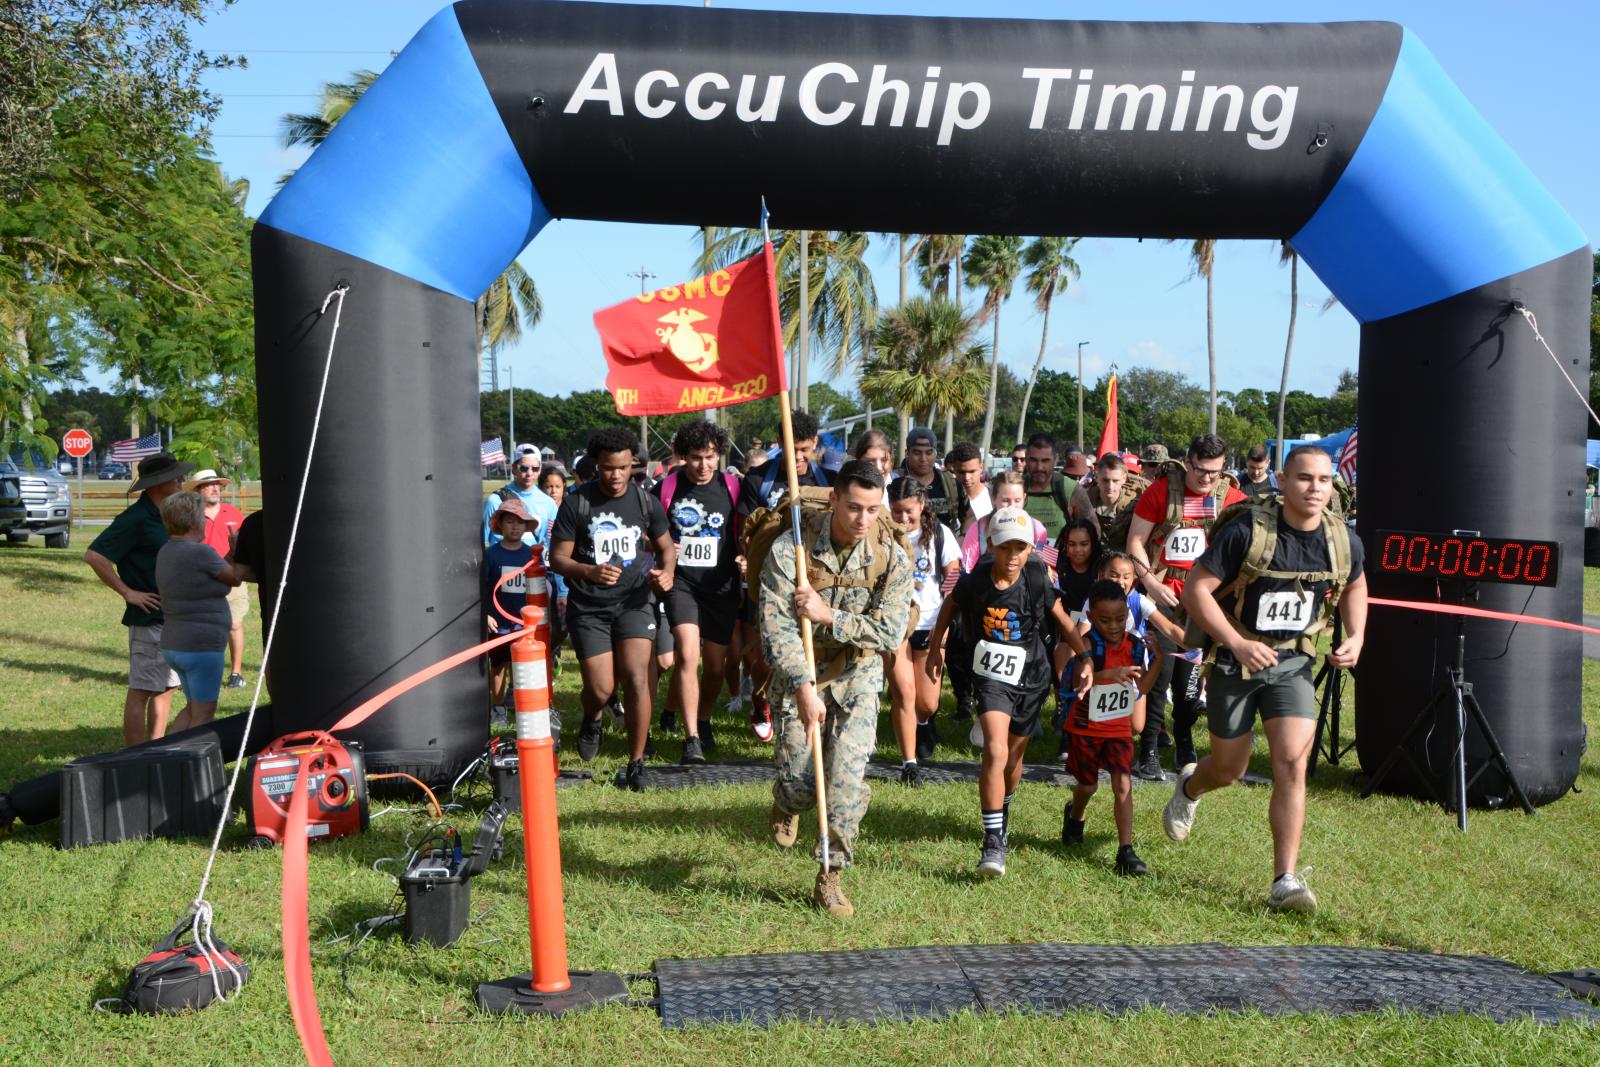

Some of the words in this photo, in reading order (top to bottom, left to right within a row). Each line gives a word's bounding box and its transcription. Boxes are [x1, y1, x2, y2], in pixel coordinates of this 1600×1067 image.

[1022, 68, 1299, 150] Timing
[678, 374, 767, 409] ANGLICO
[66, 438, 90, 448] STOP
[601, 536, 629, 556] 406
[684, 543, 711, 560] 408
[1171, 536, 1199, 553] 437
[1382, 535, 1550, 581] 00:00:00
[1266, 600, 1301, 621] 441
[980, 650, 1017, 676] 425
[1096, 689, 1129, 712] 426
[268, 782, 286, 791] 2300
